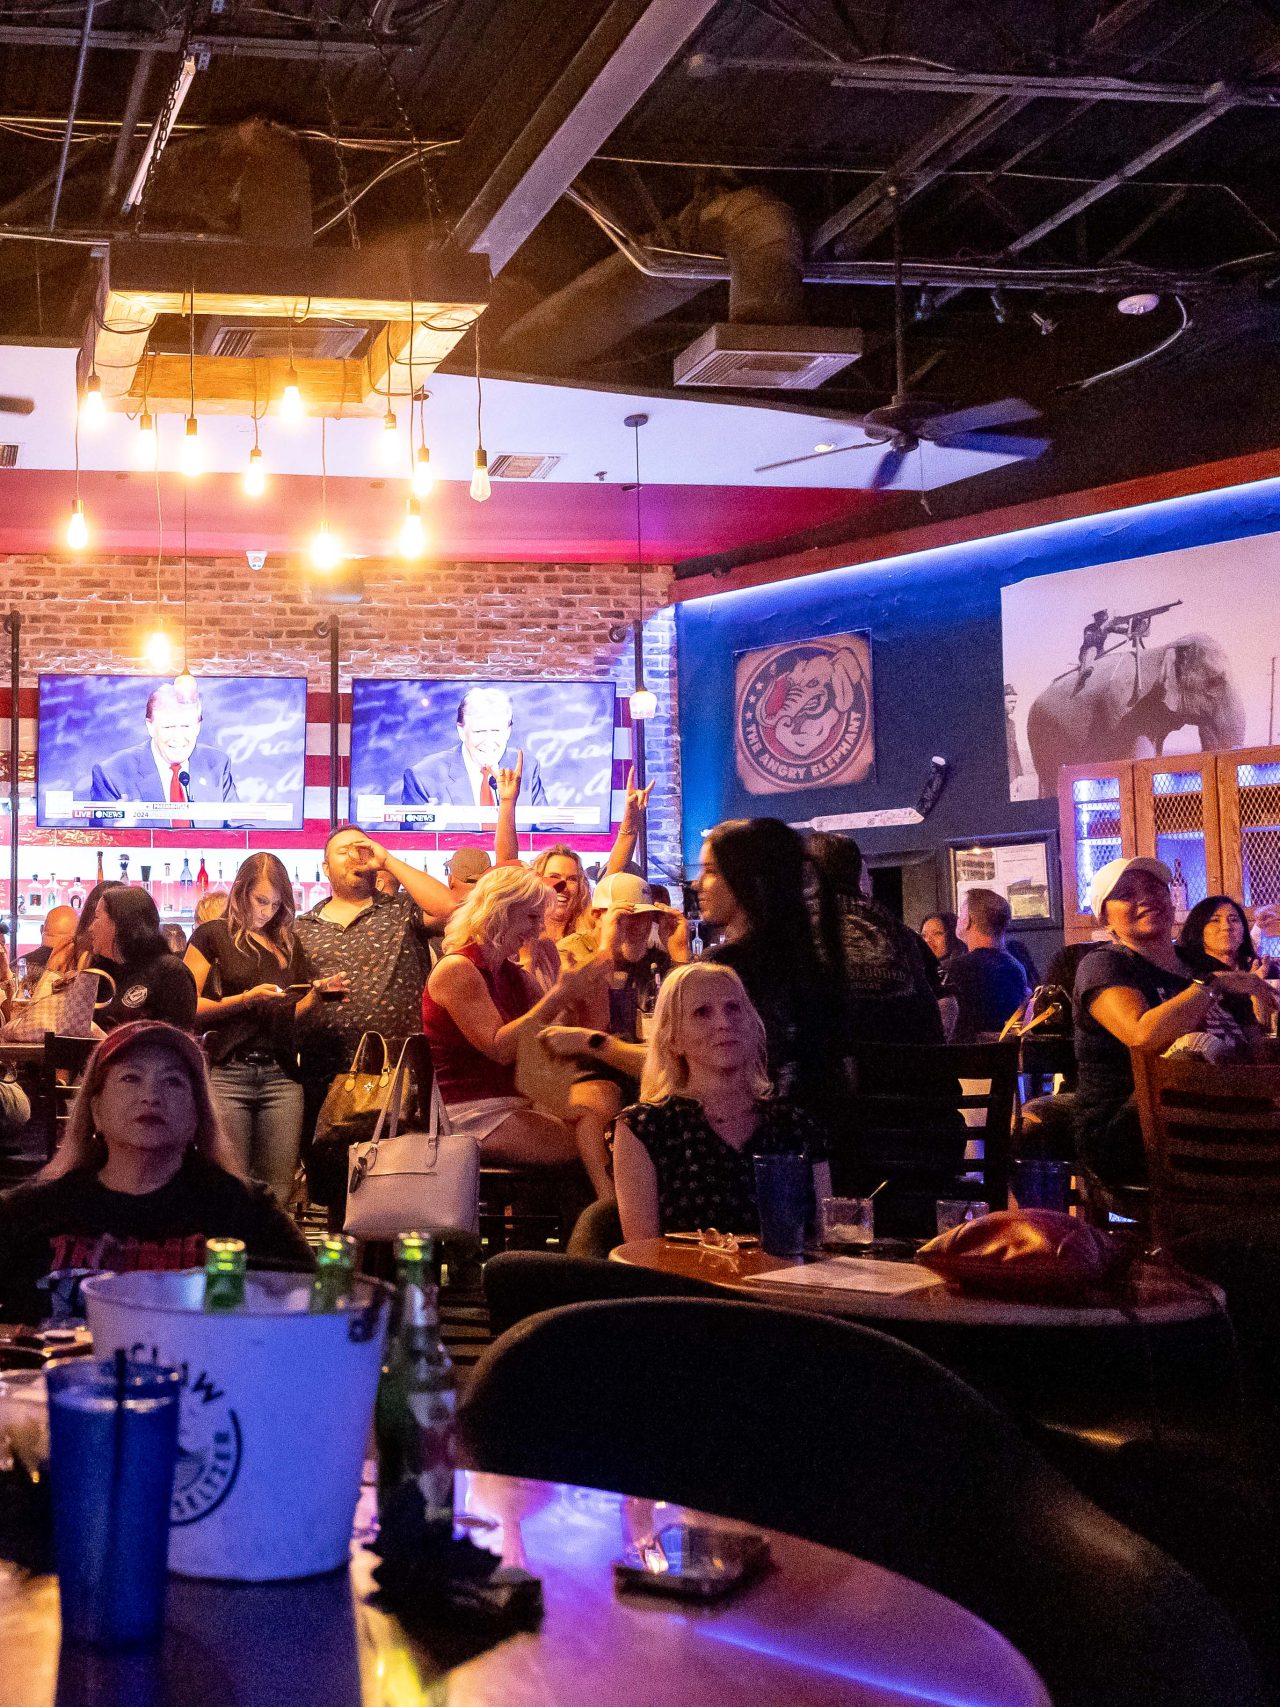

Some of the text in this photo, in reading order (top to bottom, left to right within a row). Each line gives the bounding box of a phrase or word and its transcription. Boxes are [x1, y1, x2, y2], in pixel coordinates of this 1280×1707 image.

[745, 711, 863, 780] THE ANGRY ELEPHANT
[74, 810, 123, 818] LIVE NEWS
[385, 814, 435, 822] LIVE NEWS
